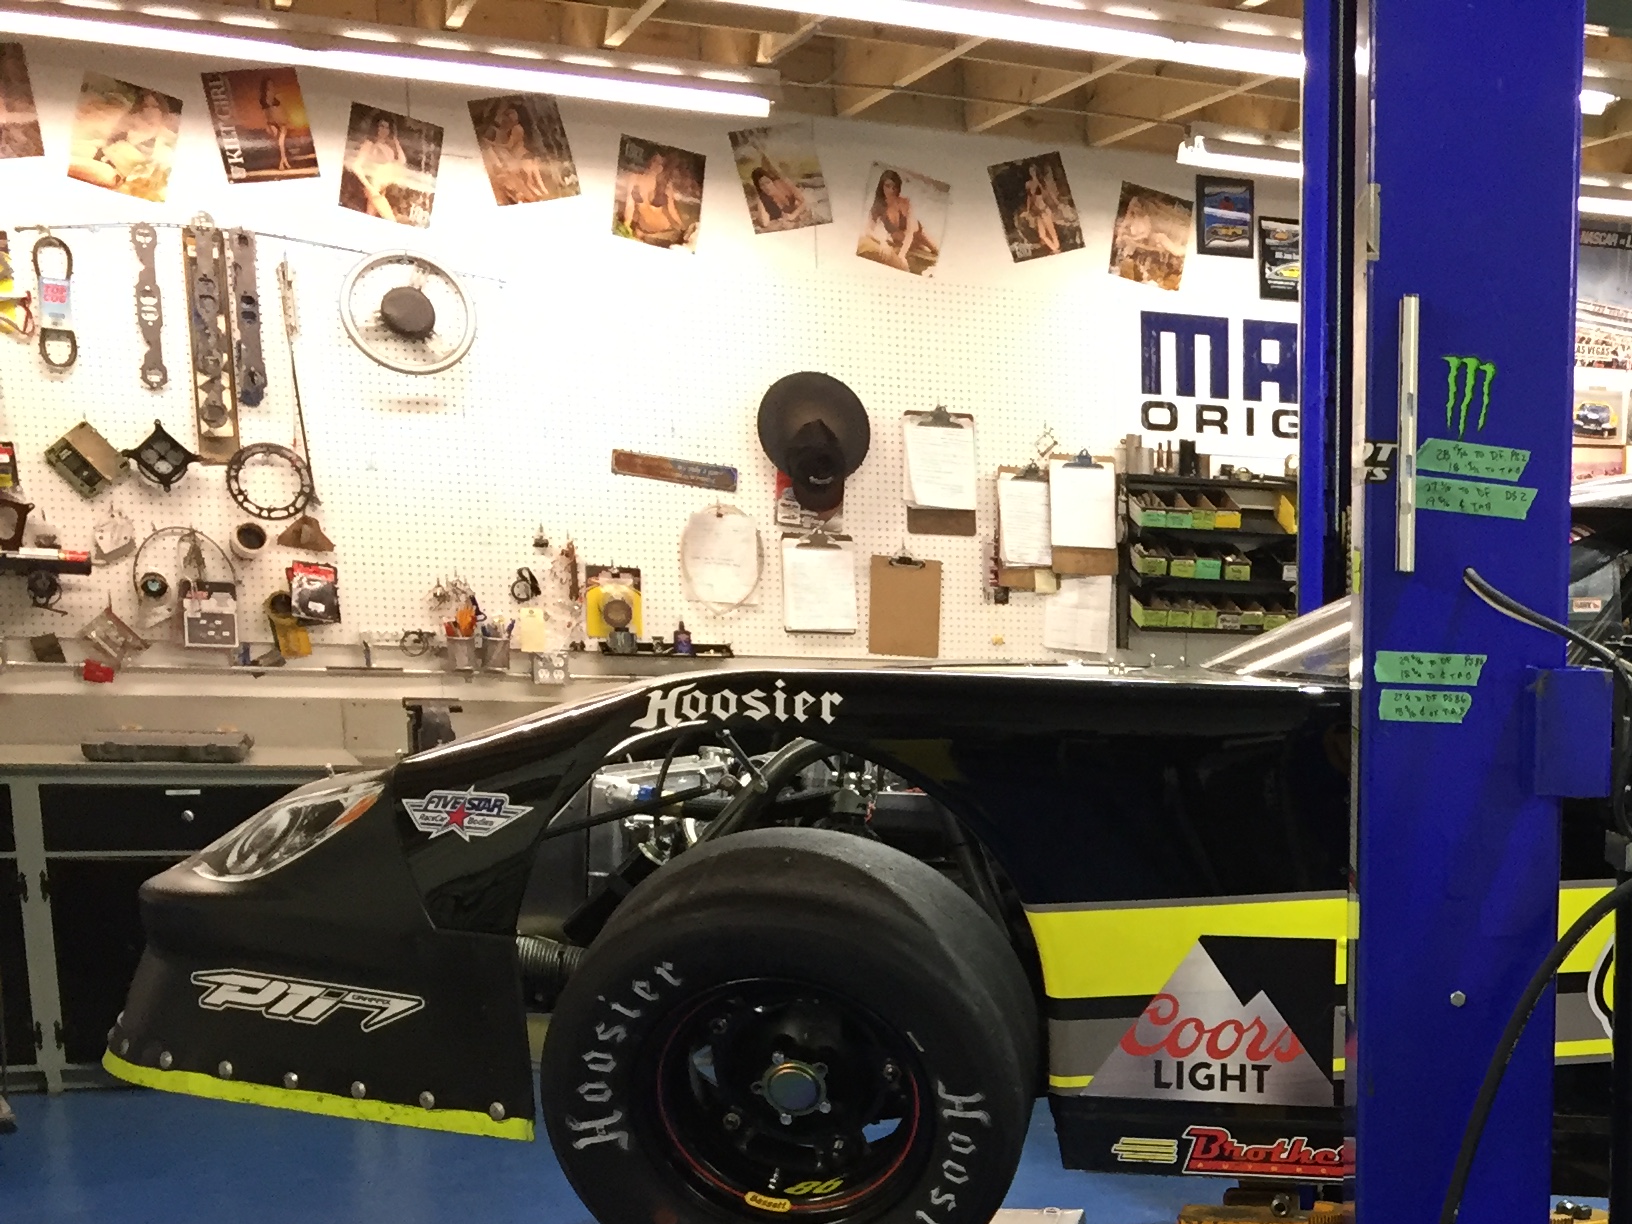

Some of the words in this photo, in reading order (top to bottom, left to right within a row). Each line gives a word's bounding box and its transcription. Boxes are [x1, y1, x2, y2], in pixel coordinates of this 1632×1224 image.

[1580, 230, 1618, 247] NASCAR
[1140, 310, 1298, 404] MA
[1141, 400, 1298, 440] ORIG
[629, 679, 844, 730] Hoosier
[422, 795, 465, 811] FIVE
[465, 797, 505, 815] STAR
[1119, 993, 1305, 1063] Coors
[565, 962, 684, 1150] Hoosier
[1153, 1060, 1273, 1093] LIGHT
[1187, 1126, 1345, 1166] Brothe
[1196, 1161, 1329, 1175] AUTOBO
